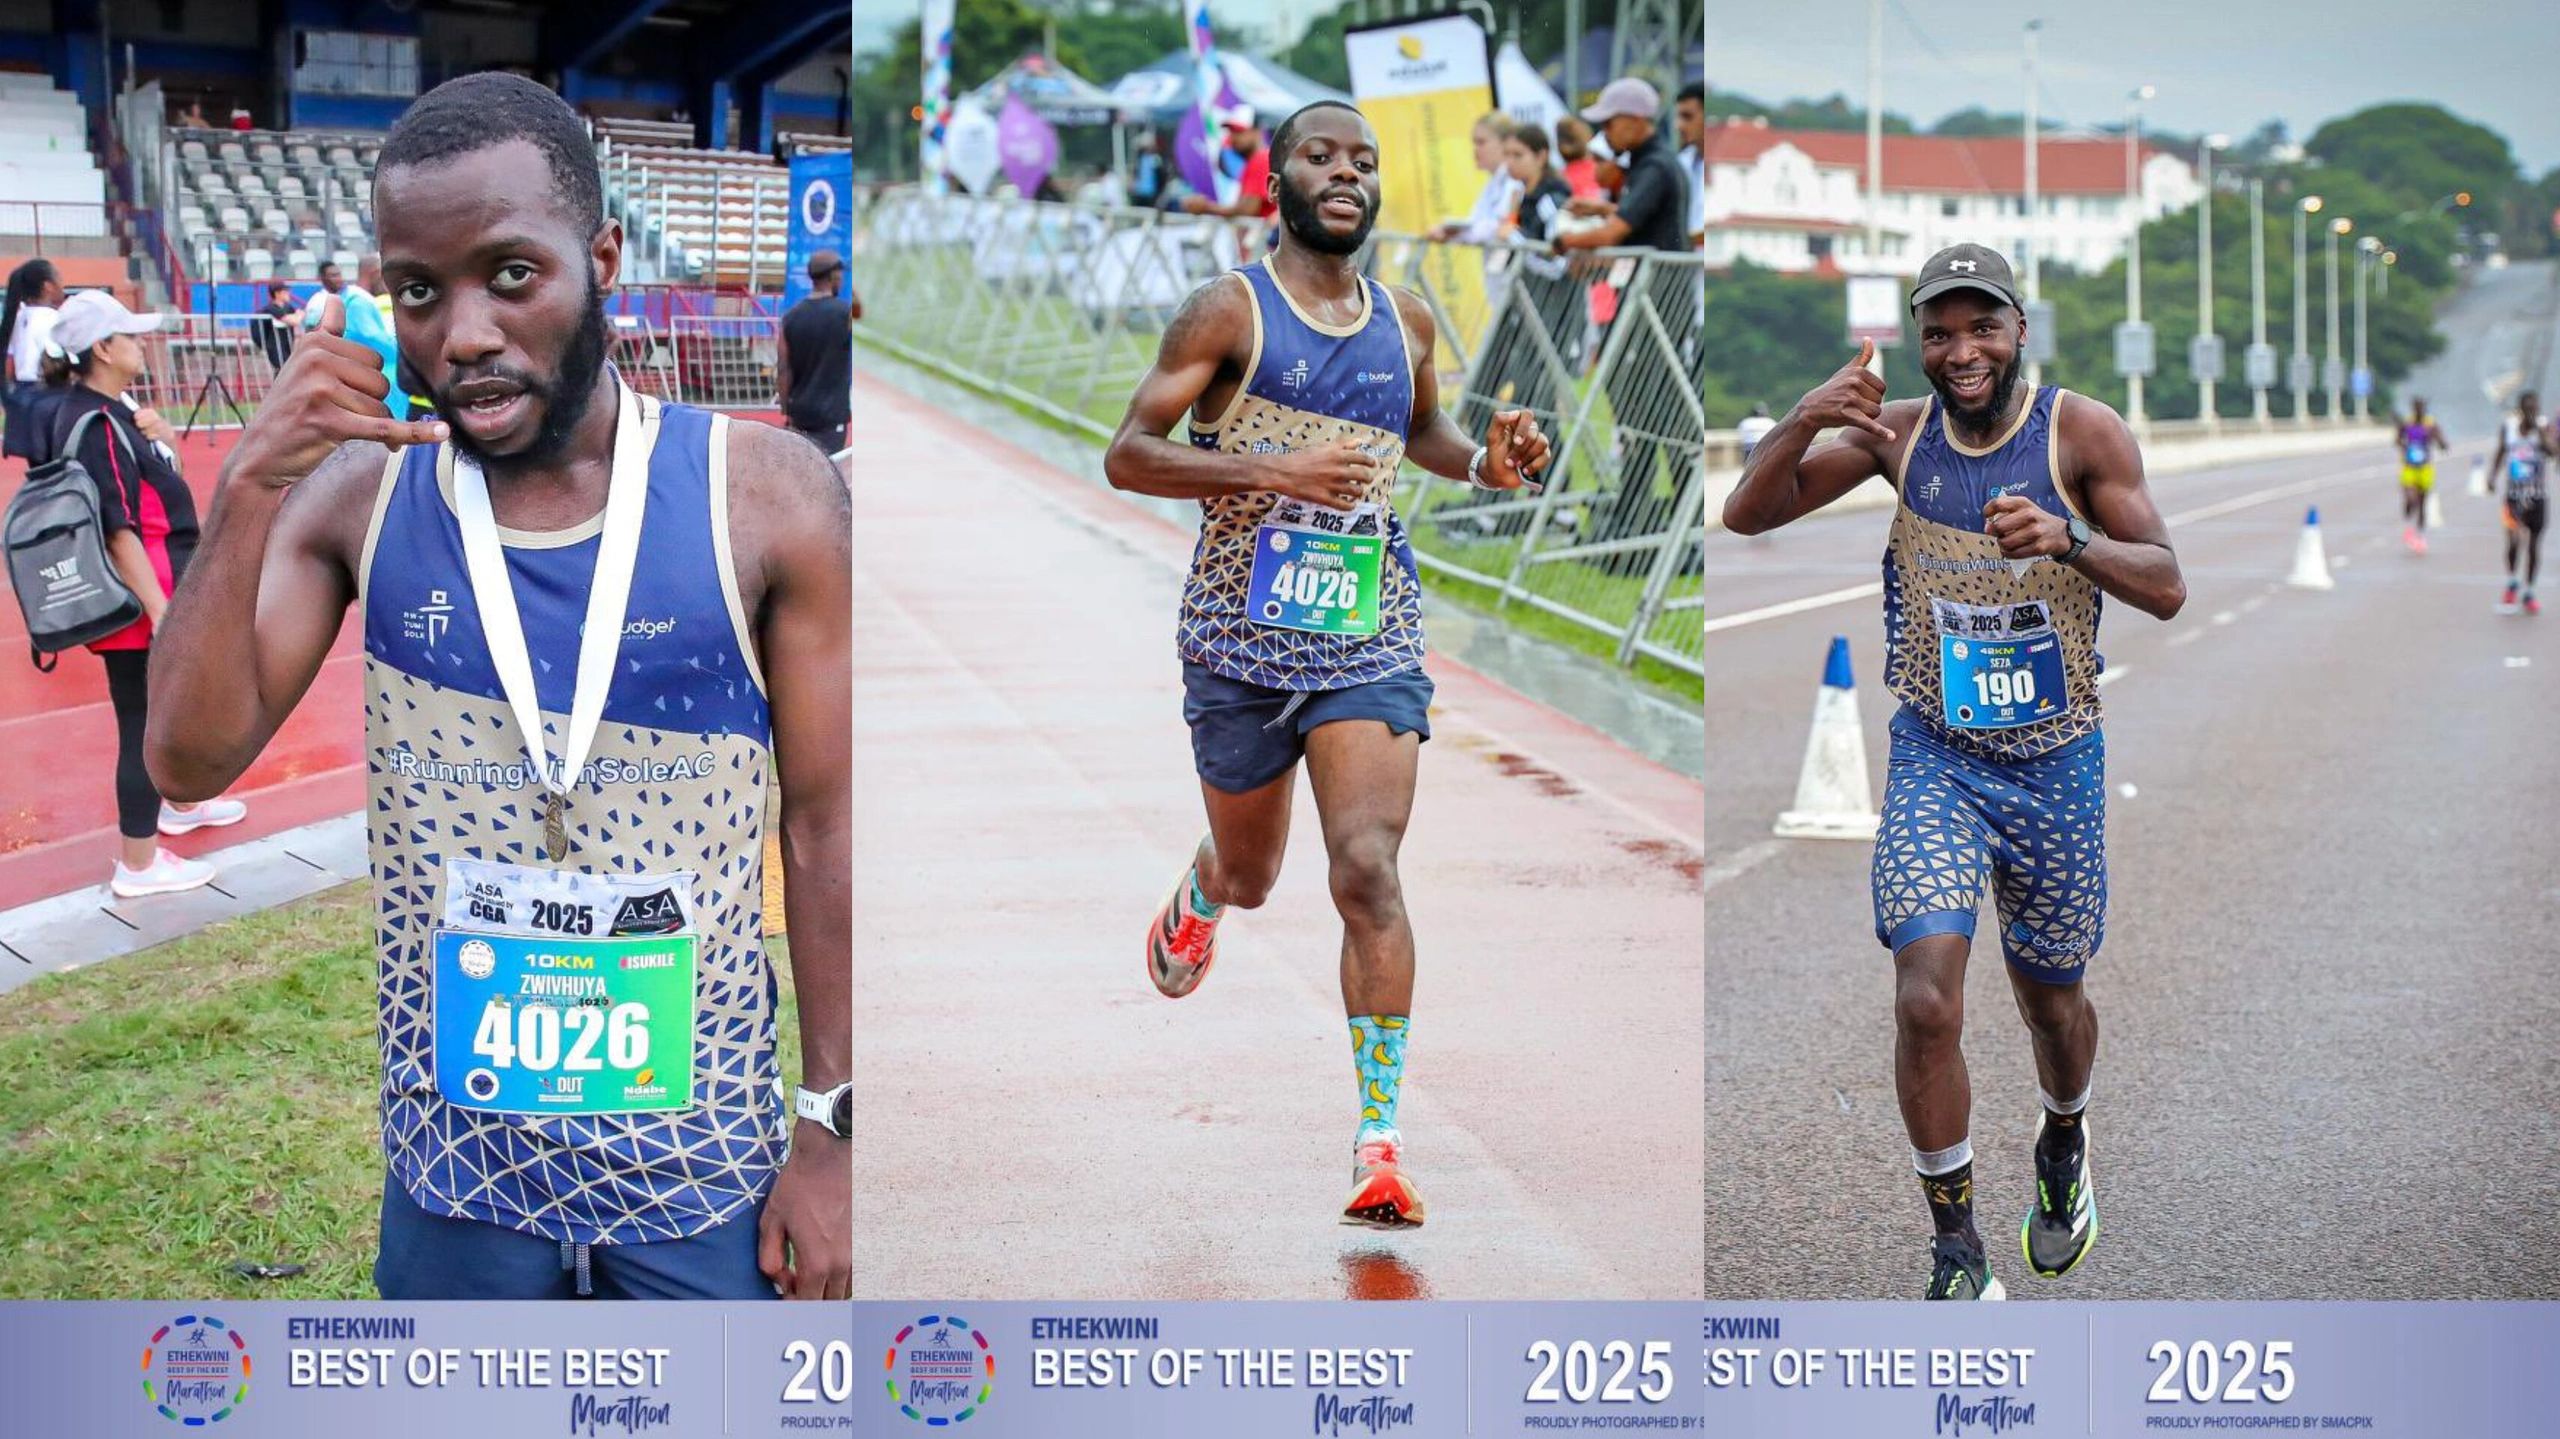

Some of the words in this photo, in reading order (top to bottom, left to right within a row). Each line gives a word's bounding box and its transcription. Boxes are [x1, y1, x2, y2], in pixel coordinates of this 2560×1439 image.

[1311, 511, 1344, 533] 2025
[1305, 540, 1341, 552] 10KM
[1270, 562, 1359, 609] 4026
[1971, 615, 2002, 631] 2025
[2014, 607, 2041, 621] ASA
[621, 616, 677, 640] udget
[1972, 669, 2036, 706] 190
[387, 750, 715, 790] #RunningWihSoleAC
[475, 882, 503, 899] ASA
[469, 900, 507, 925] CGA
[531, 898, 593, 936] 2025
[620, 894, 676, 921] ASA
[524, 953, 595, 969] 10KM
[520, 974, 607, 996] ZWIVHUYA
[473, 1000, 650, 1071] 4026
